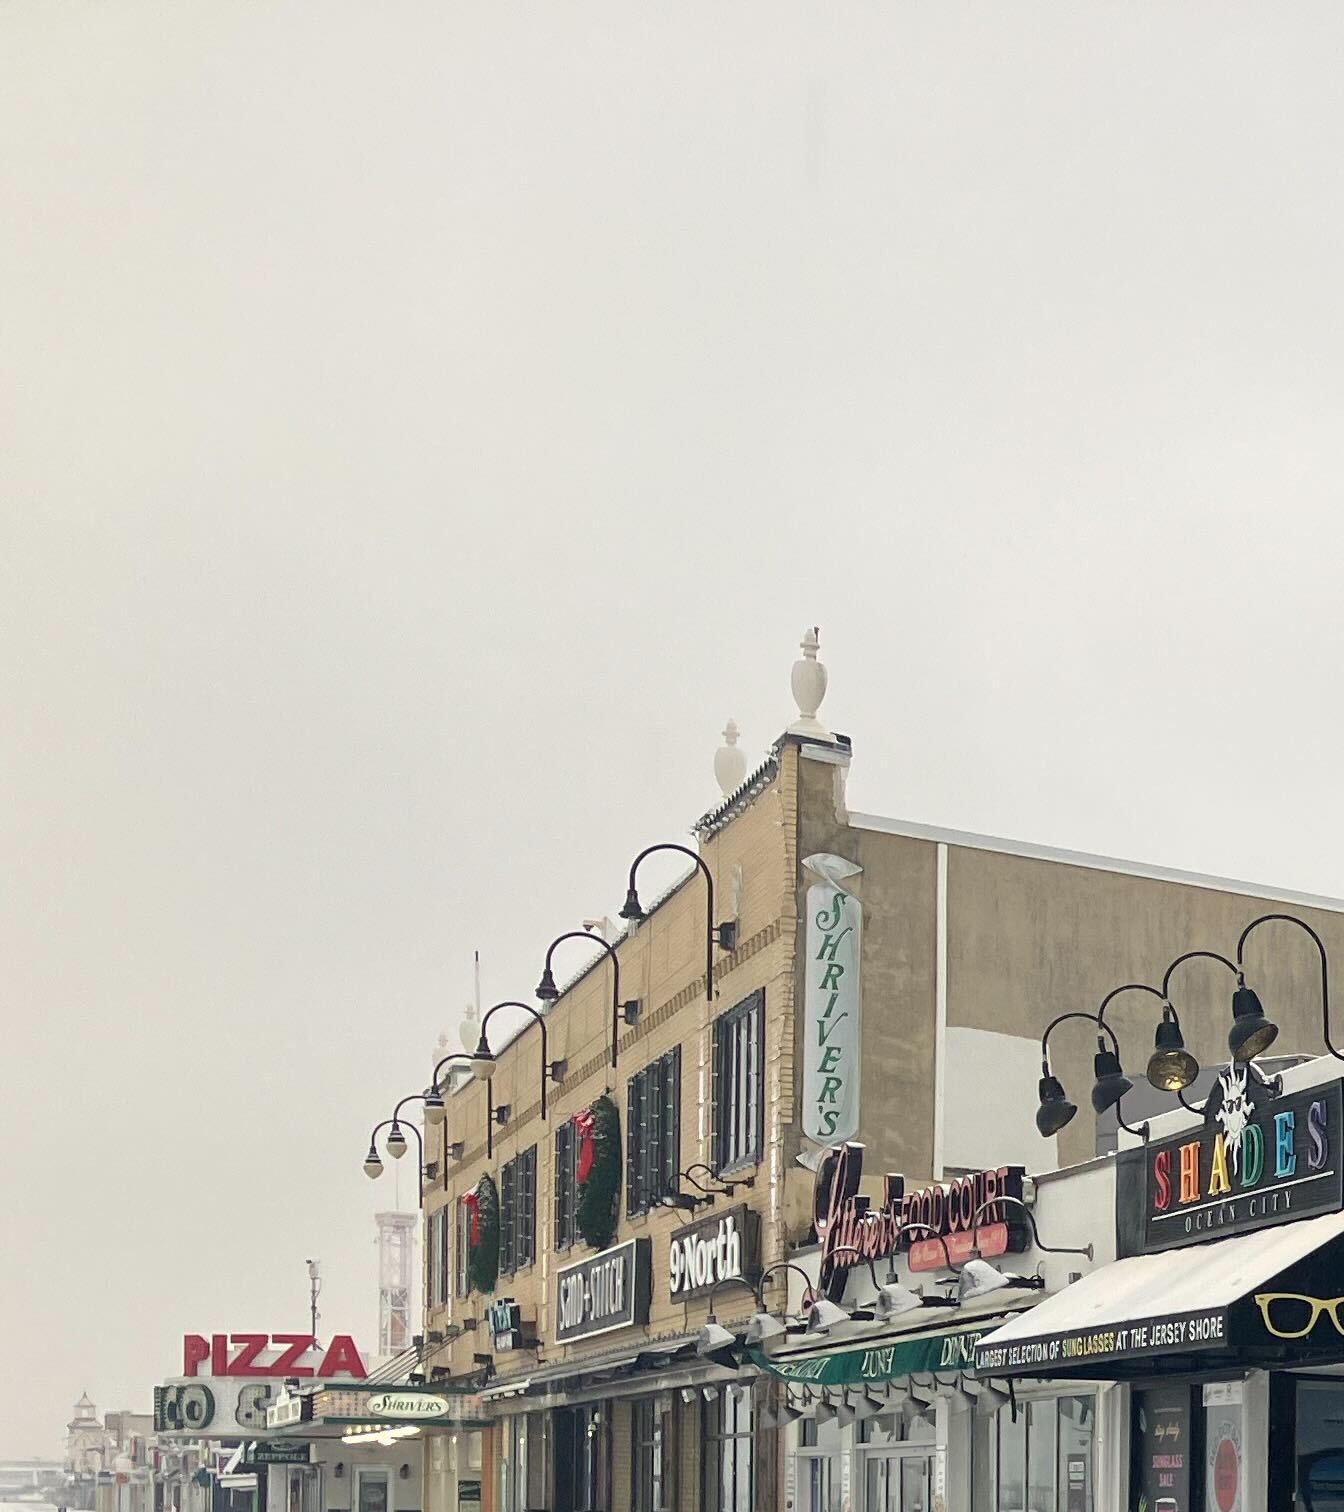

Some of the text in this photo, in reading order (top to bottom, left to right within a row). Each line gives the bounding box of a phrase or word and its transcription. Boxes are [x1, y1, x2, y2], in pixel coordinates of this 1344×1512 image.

[815, 892, 853, 1137] SHRIVER'S
[1154, 1099, 1329, 1211] SHADES
[901, 1166, 1009, 1241] FOOD COURT
[1184, 1189, 1293, 1233] OCEAN CITY
[590, 1255, 625, 1322] STITCH
[183, 1334, 369, 1379] PIZZA
[975, 1316, 1224, 1370] LARGEST SELECTION OF SUNGLASSES AT THE JERSEY SHORE
